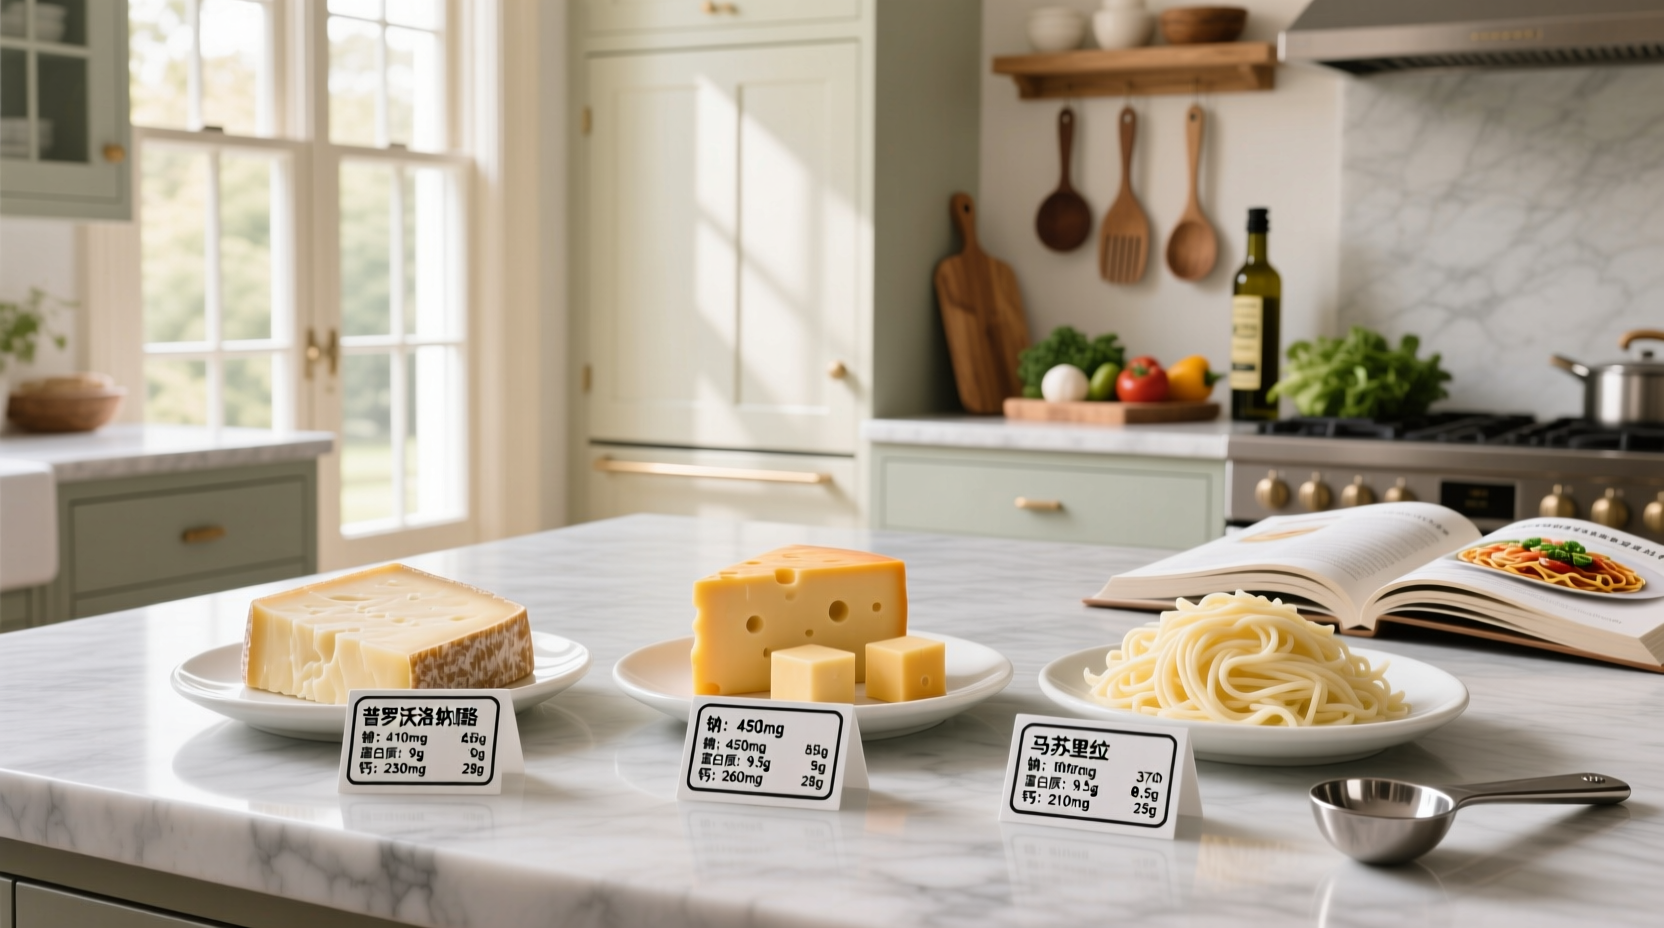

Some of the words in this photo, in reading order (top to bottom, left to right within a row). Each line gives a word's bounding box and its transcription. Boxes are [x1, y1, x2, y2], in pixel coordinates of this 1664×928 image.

[737, 719, 784, 738] 450mg
[386, 732, 427, 746] 410mg
[726, 739, 766, 755] 450mg
[409, 748, 424, 762] 9g
[384, 763, 426, 777] 230mg
[747, 756, 770, 772] 9.5g
[722, 770, 763, 787] 260mg
[1048, 794, 1089, 811] 210mg
[1134, 803, 1156, 818] 25g
